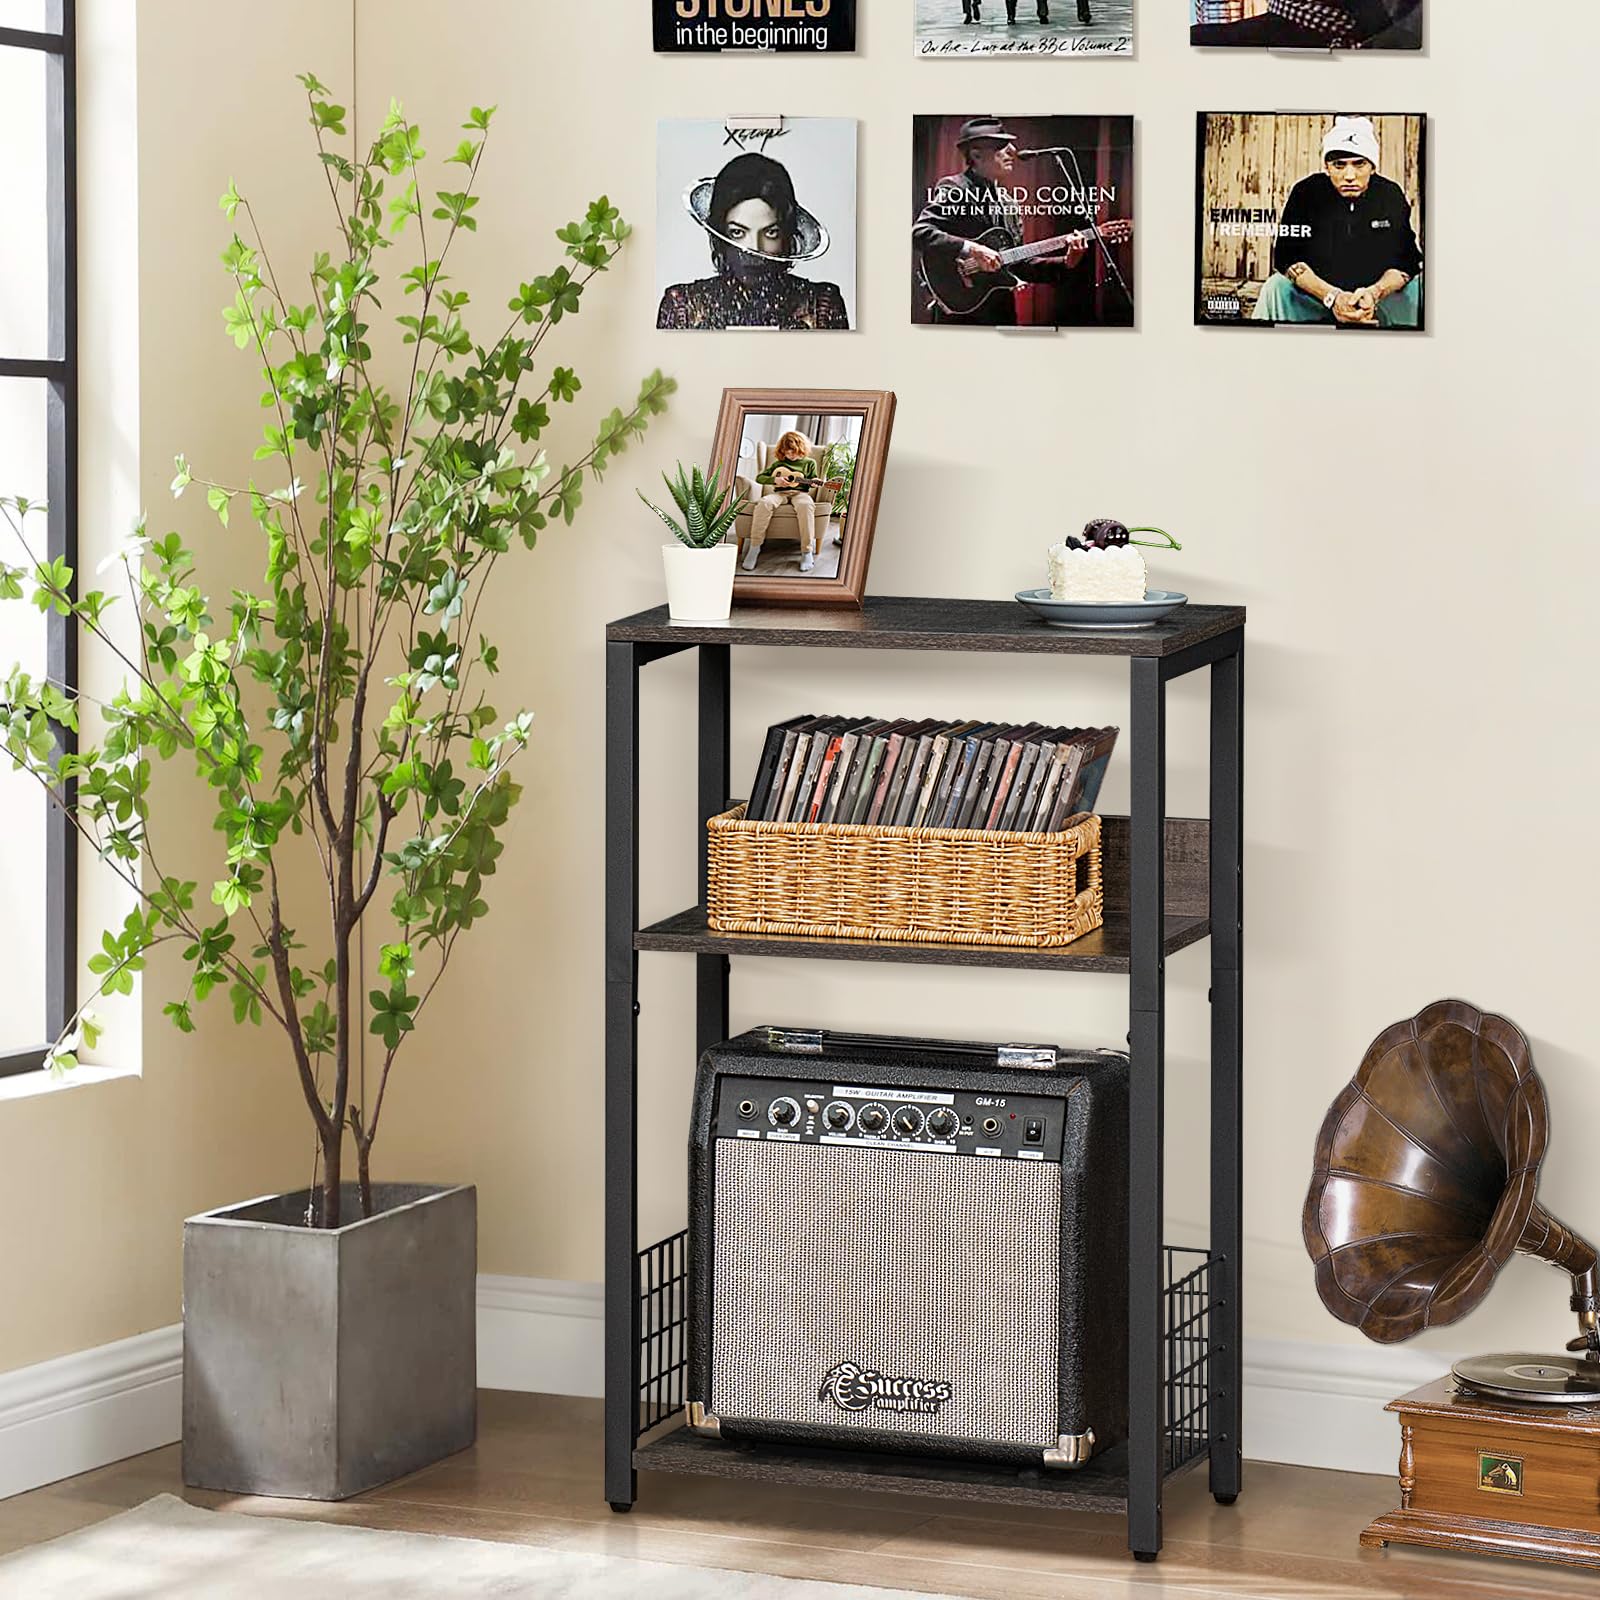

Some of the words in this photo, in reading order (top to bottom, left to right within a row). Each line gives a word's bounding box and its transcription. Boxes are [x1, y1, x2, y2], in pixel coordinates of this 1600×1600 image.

[676, 21, 692, 45] in
[695, 22, 728, 45] the
[732, 21, 828, 50] beginning
[1038, 37, 1068, 54] BBC
[1071, 37, 1113, 52] Volume
[927, 186, 1028, 204] LEONARD
[1036, 186, 1115, 203] COHEN
[941, 205, 967, 216] LIVE
[970, 205, 985, 216] IN
[988, 205, 1072, 216] FREDERICTON
[1087, 205, 1102, 216] EP
[1220, 223, 1313, 238] REMEMBER
[896, 1093, 938, 1101] AMPLIFIER
[975, 1097, 1007, 1108] GM-15
[857, 1372, 950, 1400] Success
